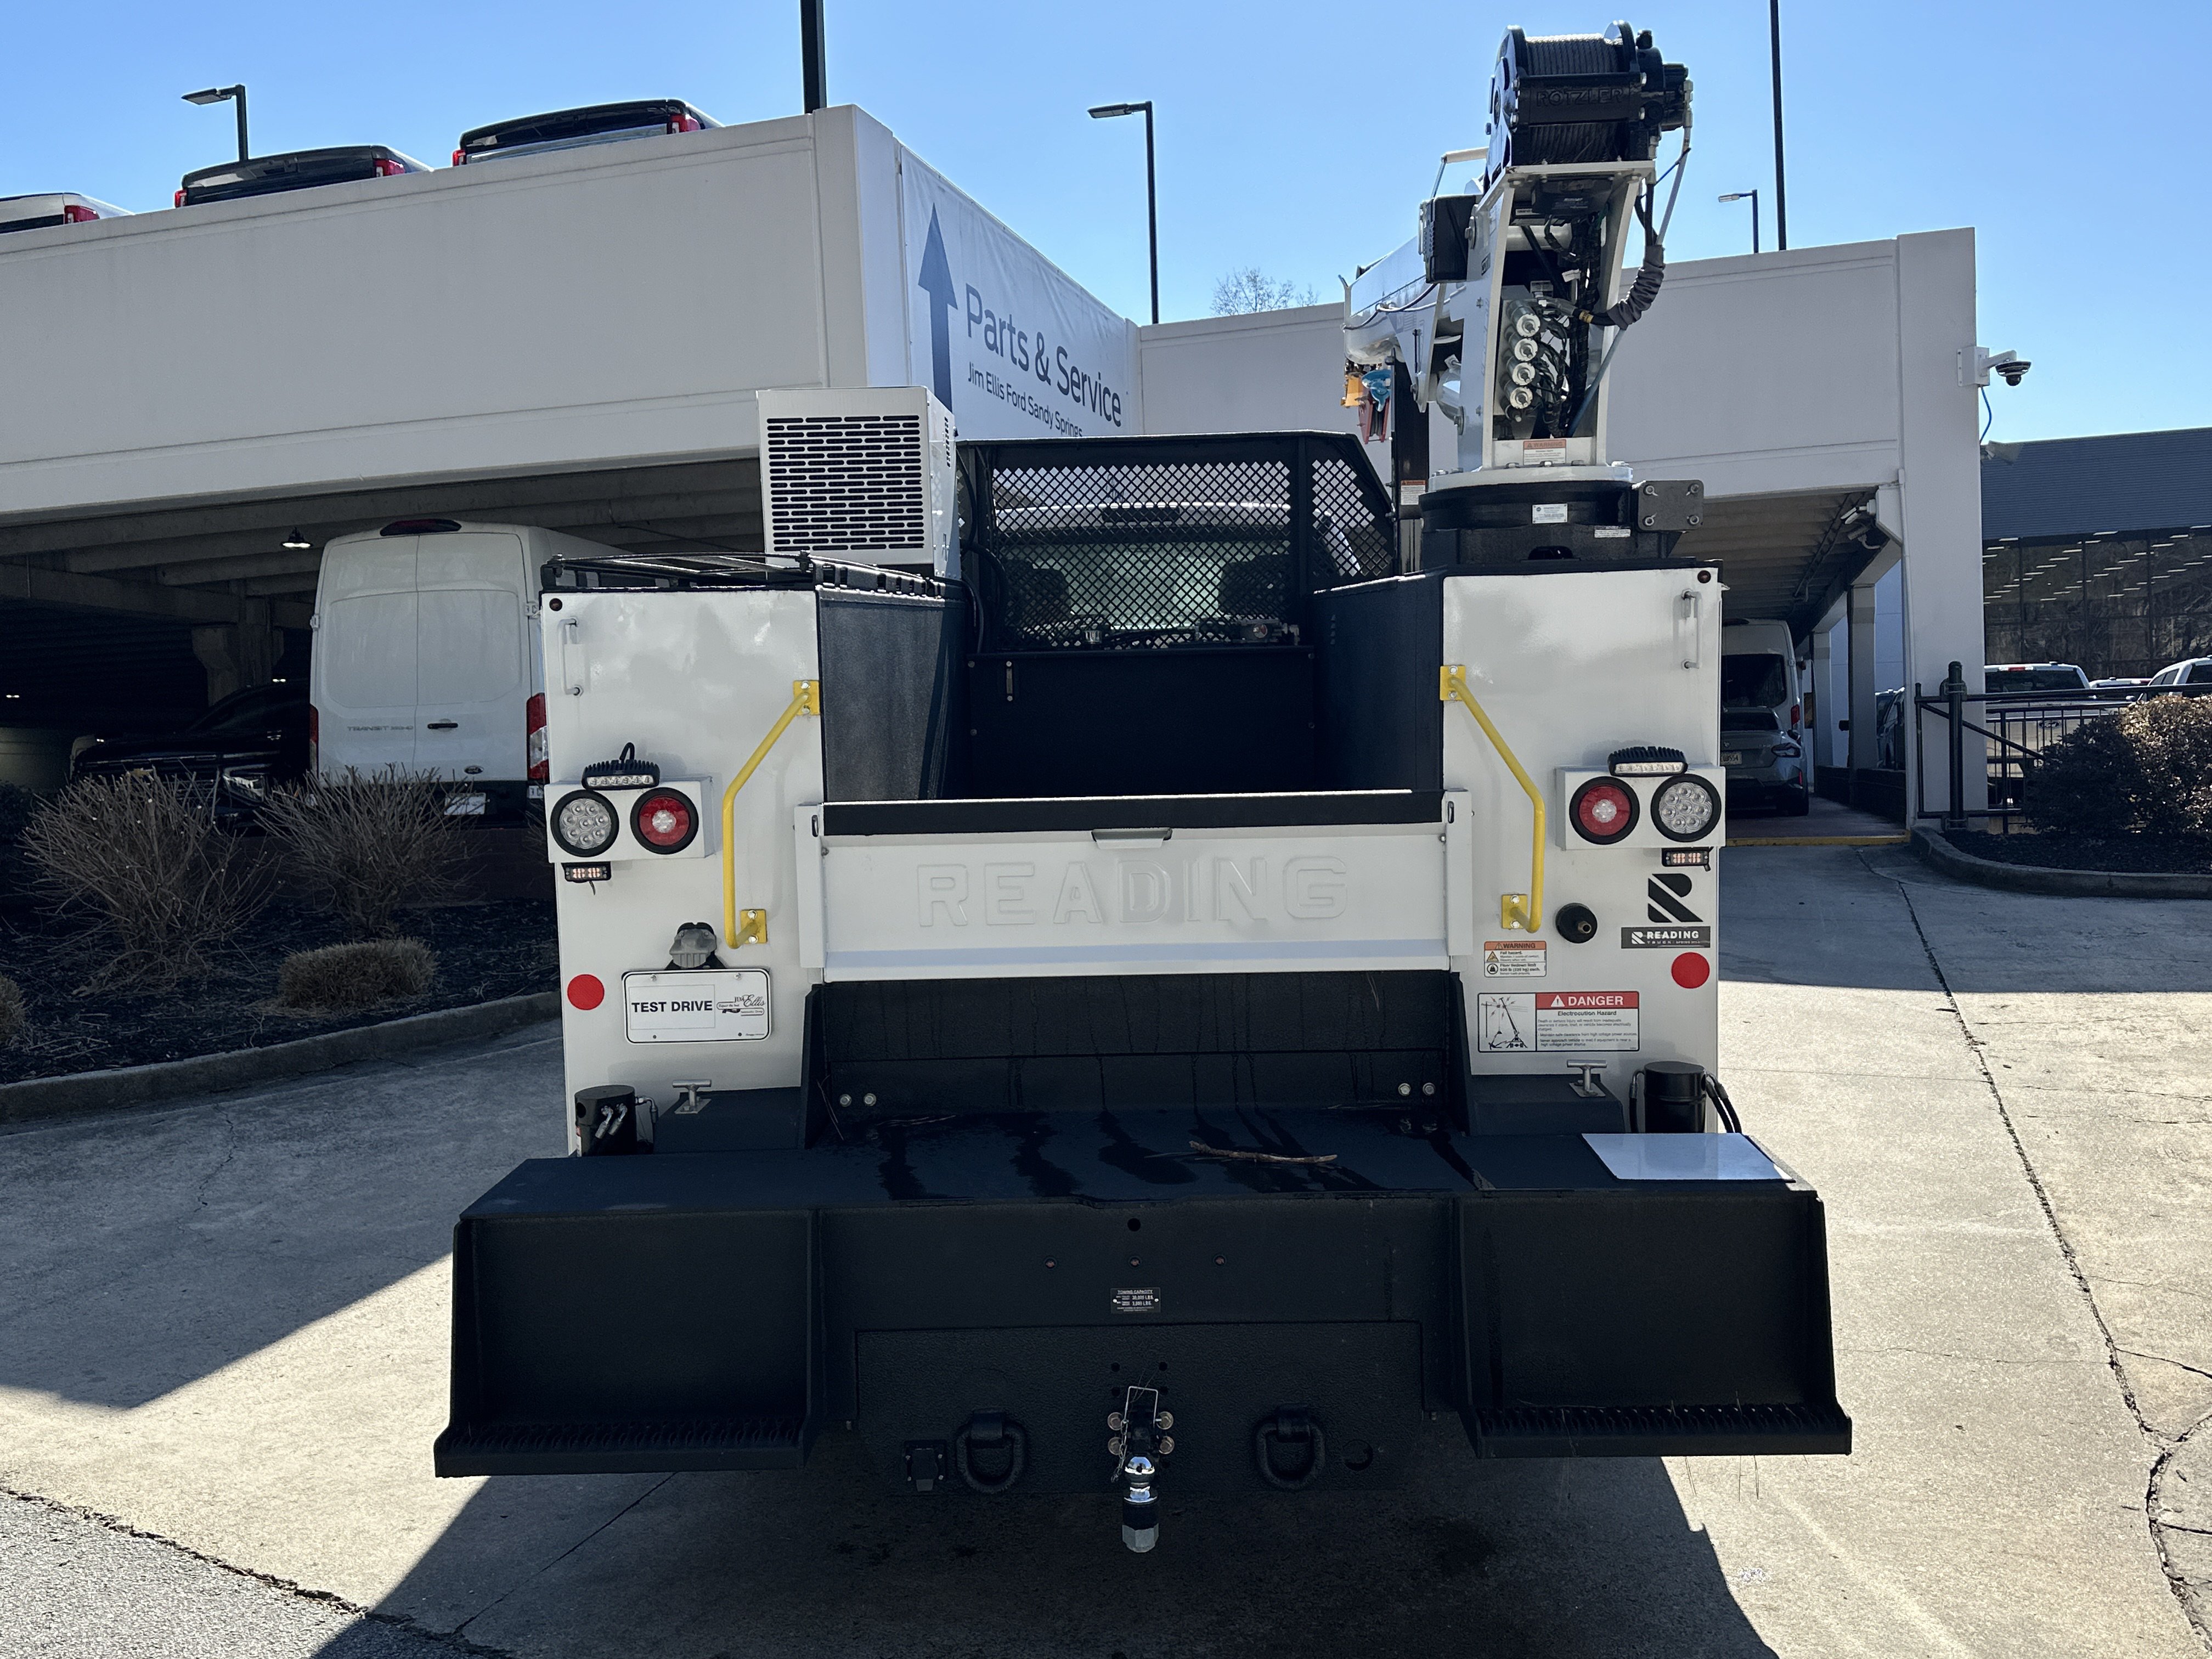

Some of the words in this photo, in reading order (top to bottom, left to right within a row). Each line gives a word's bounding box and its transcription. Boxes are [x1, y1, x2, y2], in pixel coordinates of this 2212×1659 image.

[966, 283, 1029, 372] Parts
[1035, 331, 1051, 386] &
[1056, 346, 1121, 427] Service
[968, 362, 984, 390] Jim
[986, 371, 1005, 400] Ellis
[1006, 383, 1026, 412] Ford
[1028, 395, 1053, 430] Sandy
[1055, 411, 1083, 438] Springs
[917, 856, 1348, 927] READING
[1646, 930, 1699, 939] READING
[631, 1001, 667, 1013] TEST
[672, 1000, 713, 1012] DRIVE
[1568, 996, 1624, 1006] DANGER
